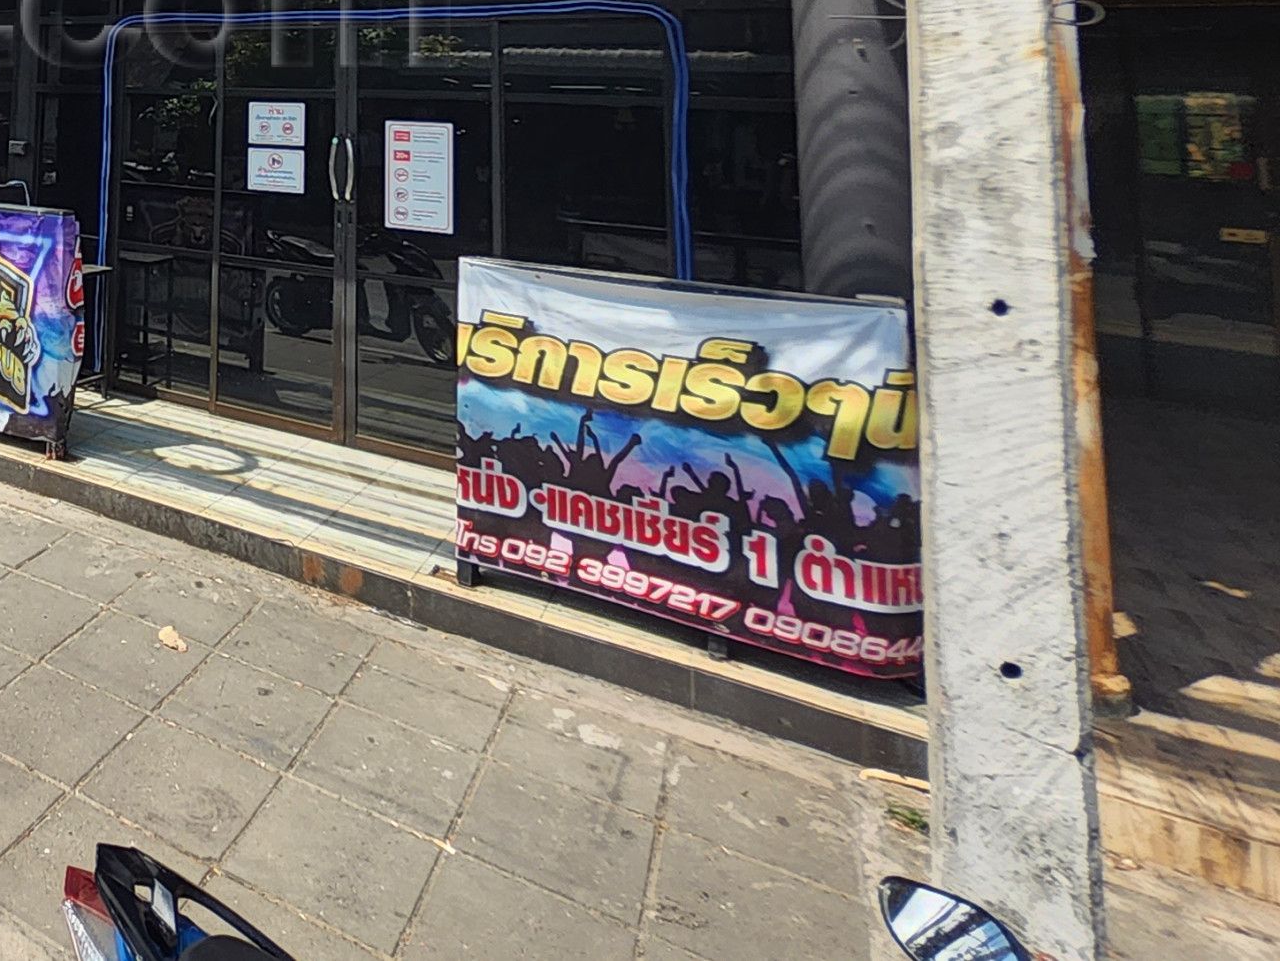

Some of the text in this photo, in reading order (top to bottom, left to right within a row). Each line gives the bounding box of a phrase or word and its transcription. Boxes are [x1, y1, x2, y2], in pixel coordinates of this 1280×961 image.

[501, 537, 570, 575] 092
[577, 557, 740, 620] 3997217
[748, 534, 768, 580] 1
